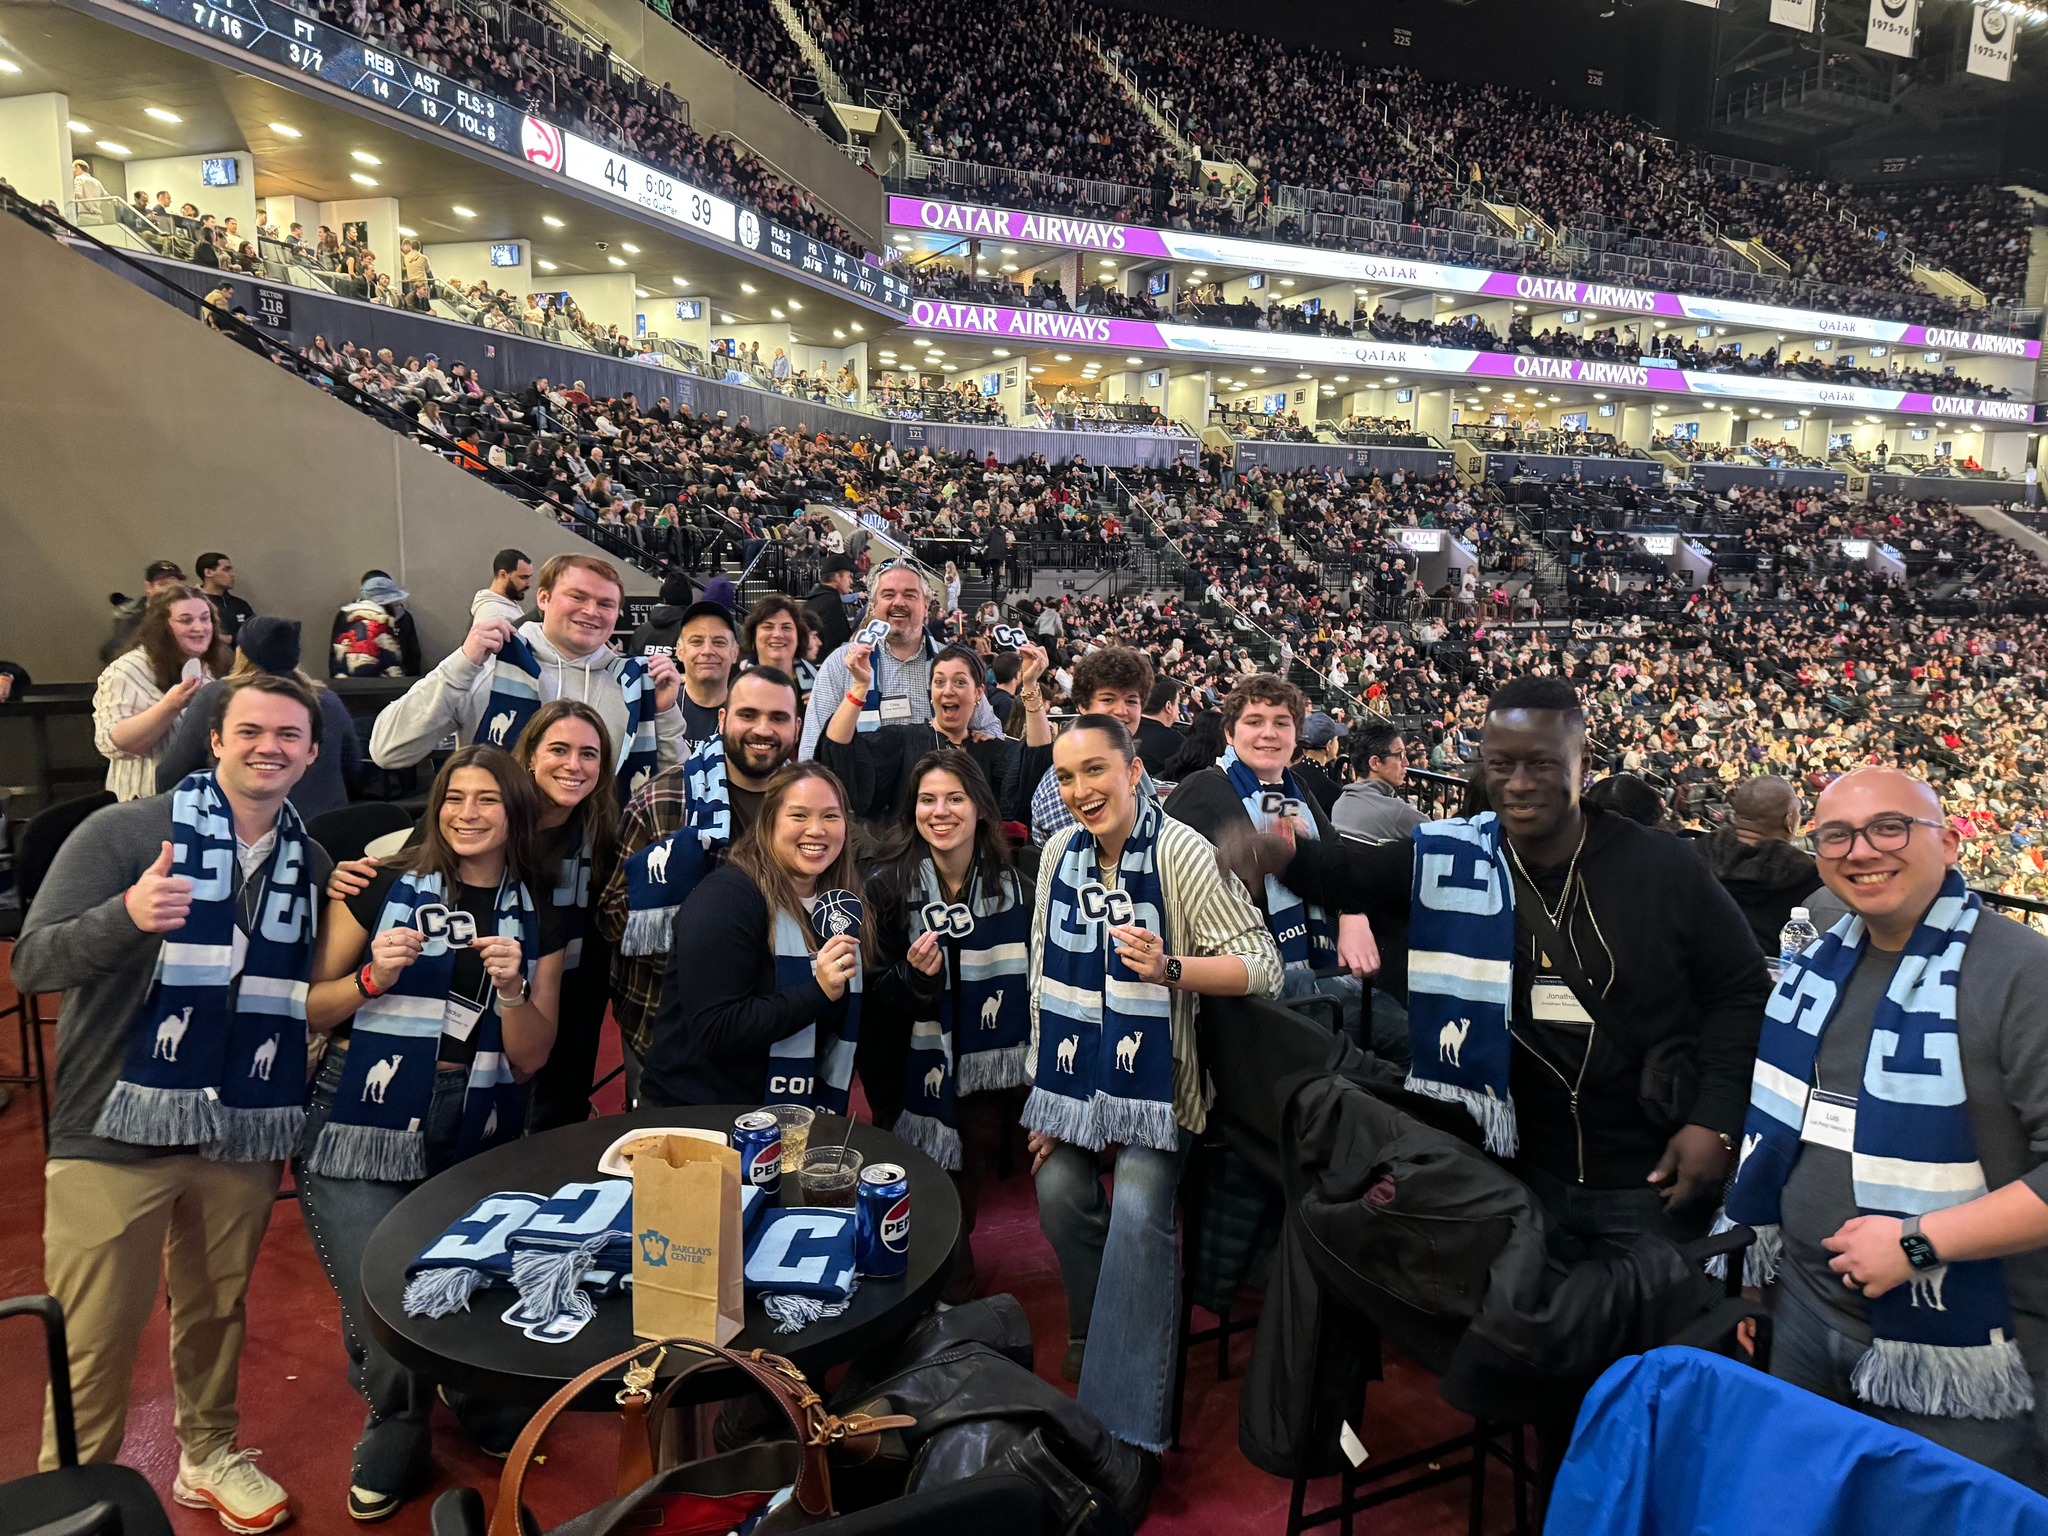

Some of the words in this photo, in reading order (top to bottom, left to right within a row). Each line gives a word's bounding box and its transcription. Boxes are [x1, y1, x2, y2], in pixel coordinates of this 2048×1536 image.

[294, 18, 315, 42] FT
[1872, 18, 1910, 36] 1975-76
[1394, 34, 1410, 46] 225
[364, 50, 394, 76] REB
[1974, 44, 2008, 62] 1973-74
[372, 78, 389, 98] 14
[414, 72, 440, 95] AST
[422, 98, 437, 118] 13
[457, 89, 484, 116] FLS:
[486, 102, 495, 118] 3
[457, 112, 486, 136] TOL:
[488, 128, 496, 142] 6
[604, 158, 628, 192] 44
[1883, 164, 1905, 172] 227
[646, 174, 672, 200] 6:02
[692, 195, 712, 226] 39
[921, 202, 1010, 236] QATAR
[1020, 214, 1125, 250] AIRWAYS
[808, 242, 818, 256] FG
[1364, 264, 1417, 280] QATAR
[260, 289, 284, 300] SECTION
[1516, 276, 1577, 302] QATAR
[1582, 284, 1655, 311] AIRWAYS
[260, 298, 284, 314] 118
[268, 315, 279, 326] 19
[912, 302, 998, 332] QATAR
[1008, 311, 1110, 342] AIRWAYS
[1819, 320, 1856, 332] QATAR
[1925, 328, 1969, 348] QATAR
[1972, 334, 2026, 356] AIRWAYS
[1356, 349, 1406, 362] QATAR
[1514, 356, 1572, 380] QATAR
[1578, 362, 1648, 386] AIRWAYS
[1819, 390, 1855, 402] QATAR
[1932, 396, 1974, 414] QATAR
[1977, 399, 2028, 420] AIRWAYS
[631, 613, 648, 626] 11
[994, 625, 1028, 648] CC
[644, 645, 677, 656] BES
[1262, 793, 1300, 818] CC
[1080, 884, 1134, 926] CC
[418, 906, 475, 947] CC
[922, 902, 973, 937] CC
[1826, 1113, 1839, 1122] Luis
[671, 1244, 712, 1256] BARCLAYS
